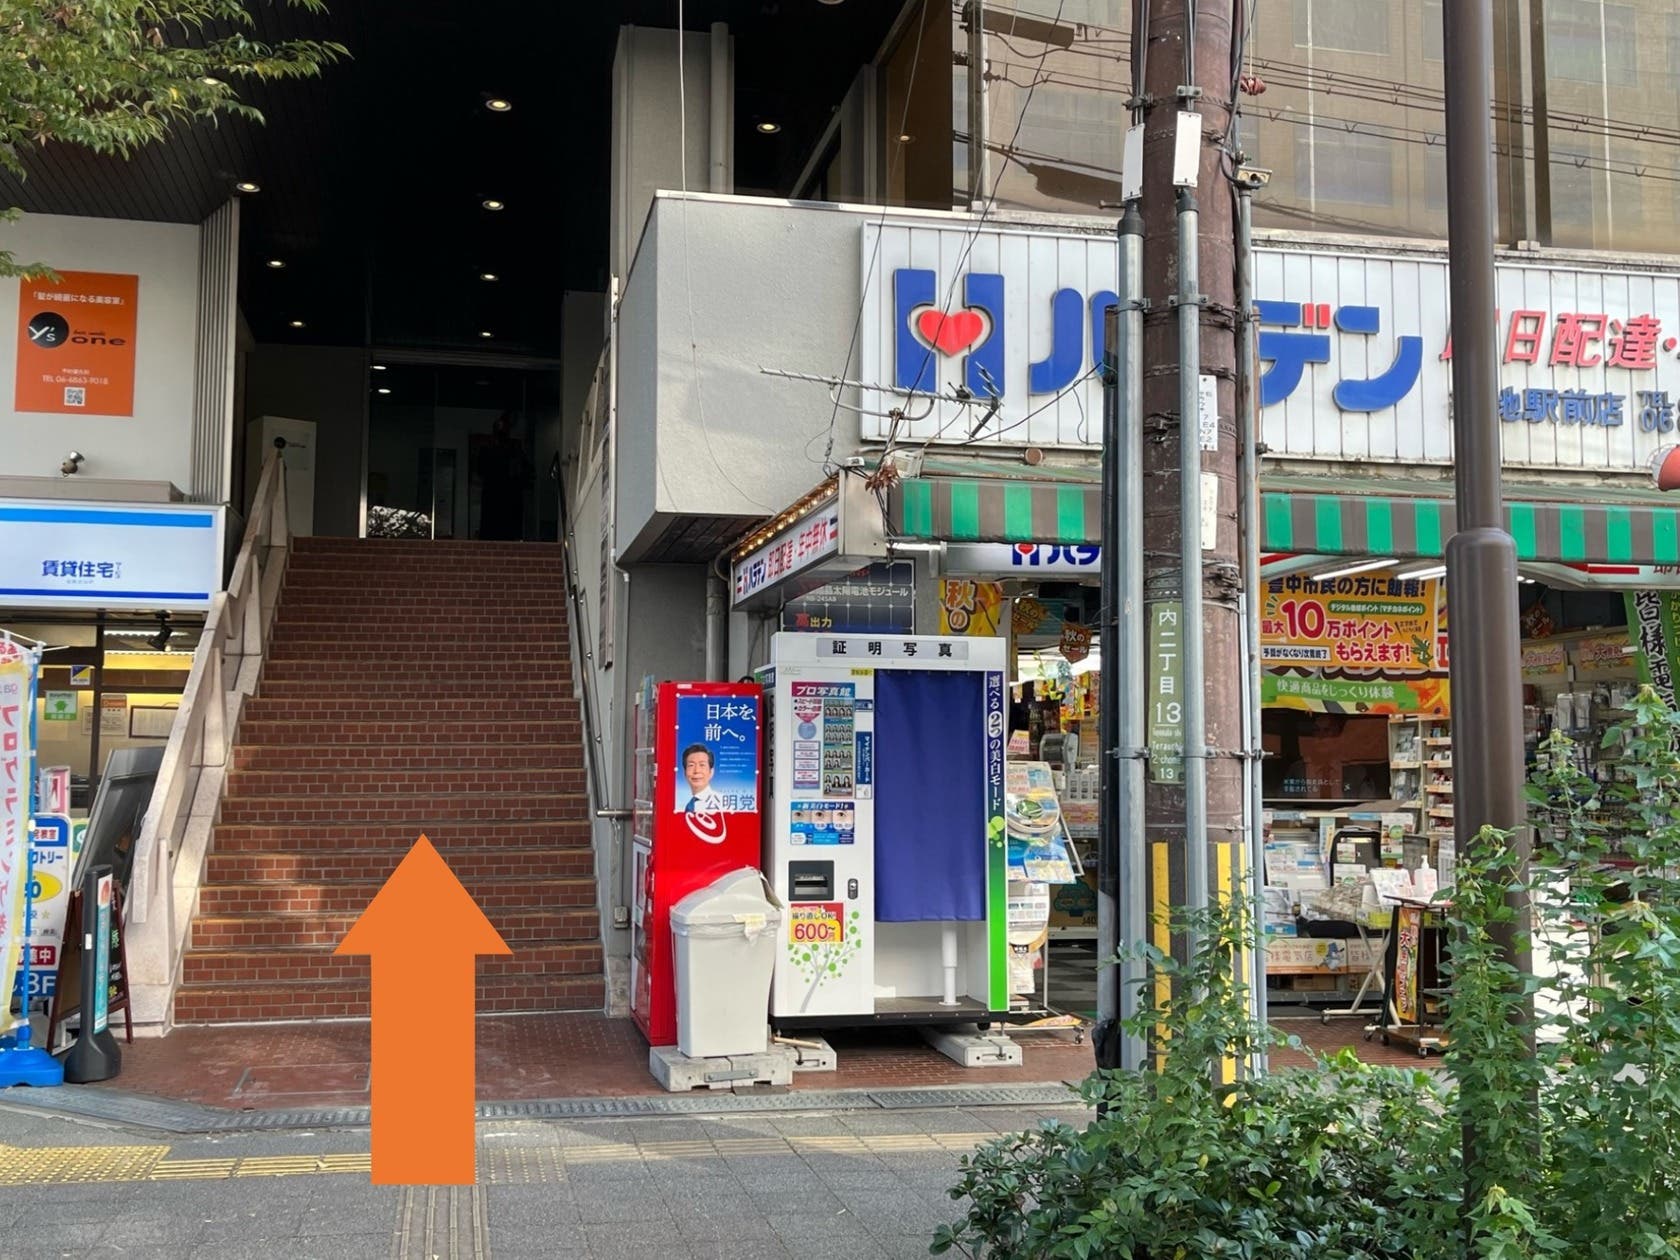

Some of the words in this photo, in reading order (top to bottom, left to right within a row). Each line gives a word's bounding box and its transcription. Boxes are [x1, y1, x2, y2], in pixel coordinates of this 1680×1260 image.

[71, 336, 126, 346] one
[1637, 391, 1674, 409] TEL
[833, 641, 952, 658] 証明写真
[1336, 642, 1410, 664] もらえます!
[1155, 702, 1181, 723] 13
[704, 724, 746, 742] 前へ。
[1160, 768, 1174, 779] 13
[705, 795, 755, 810] 公明党
